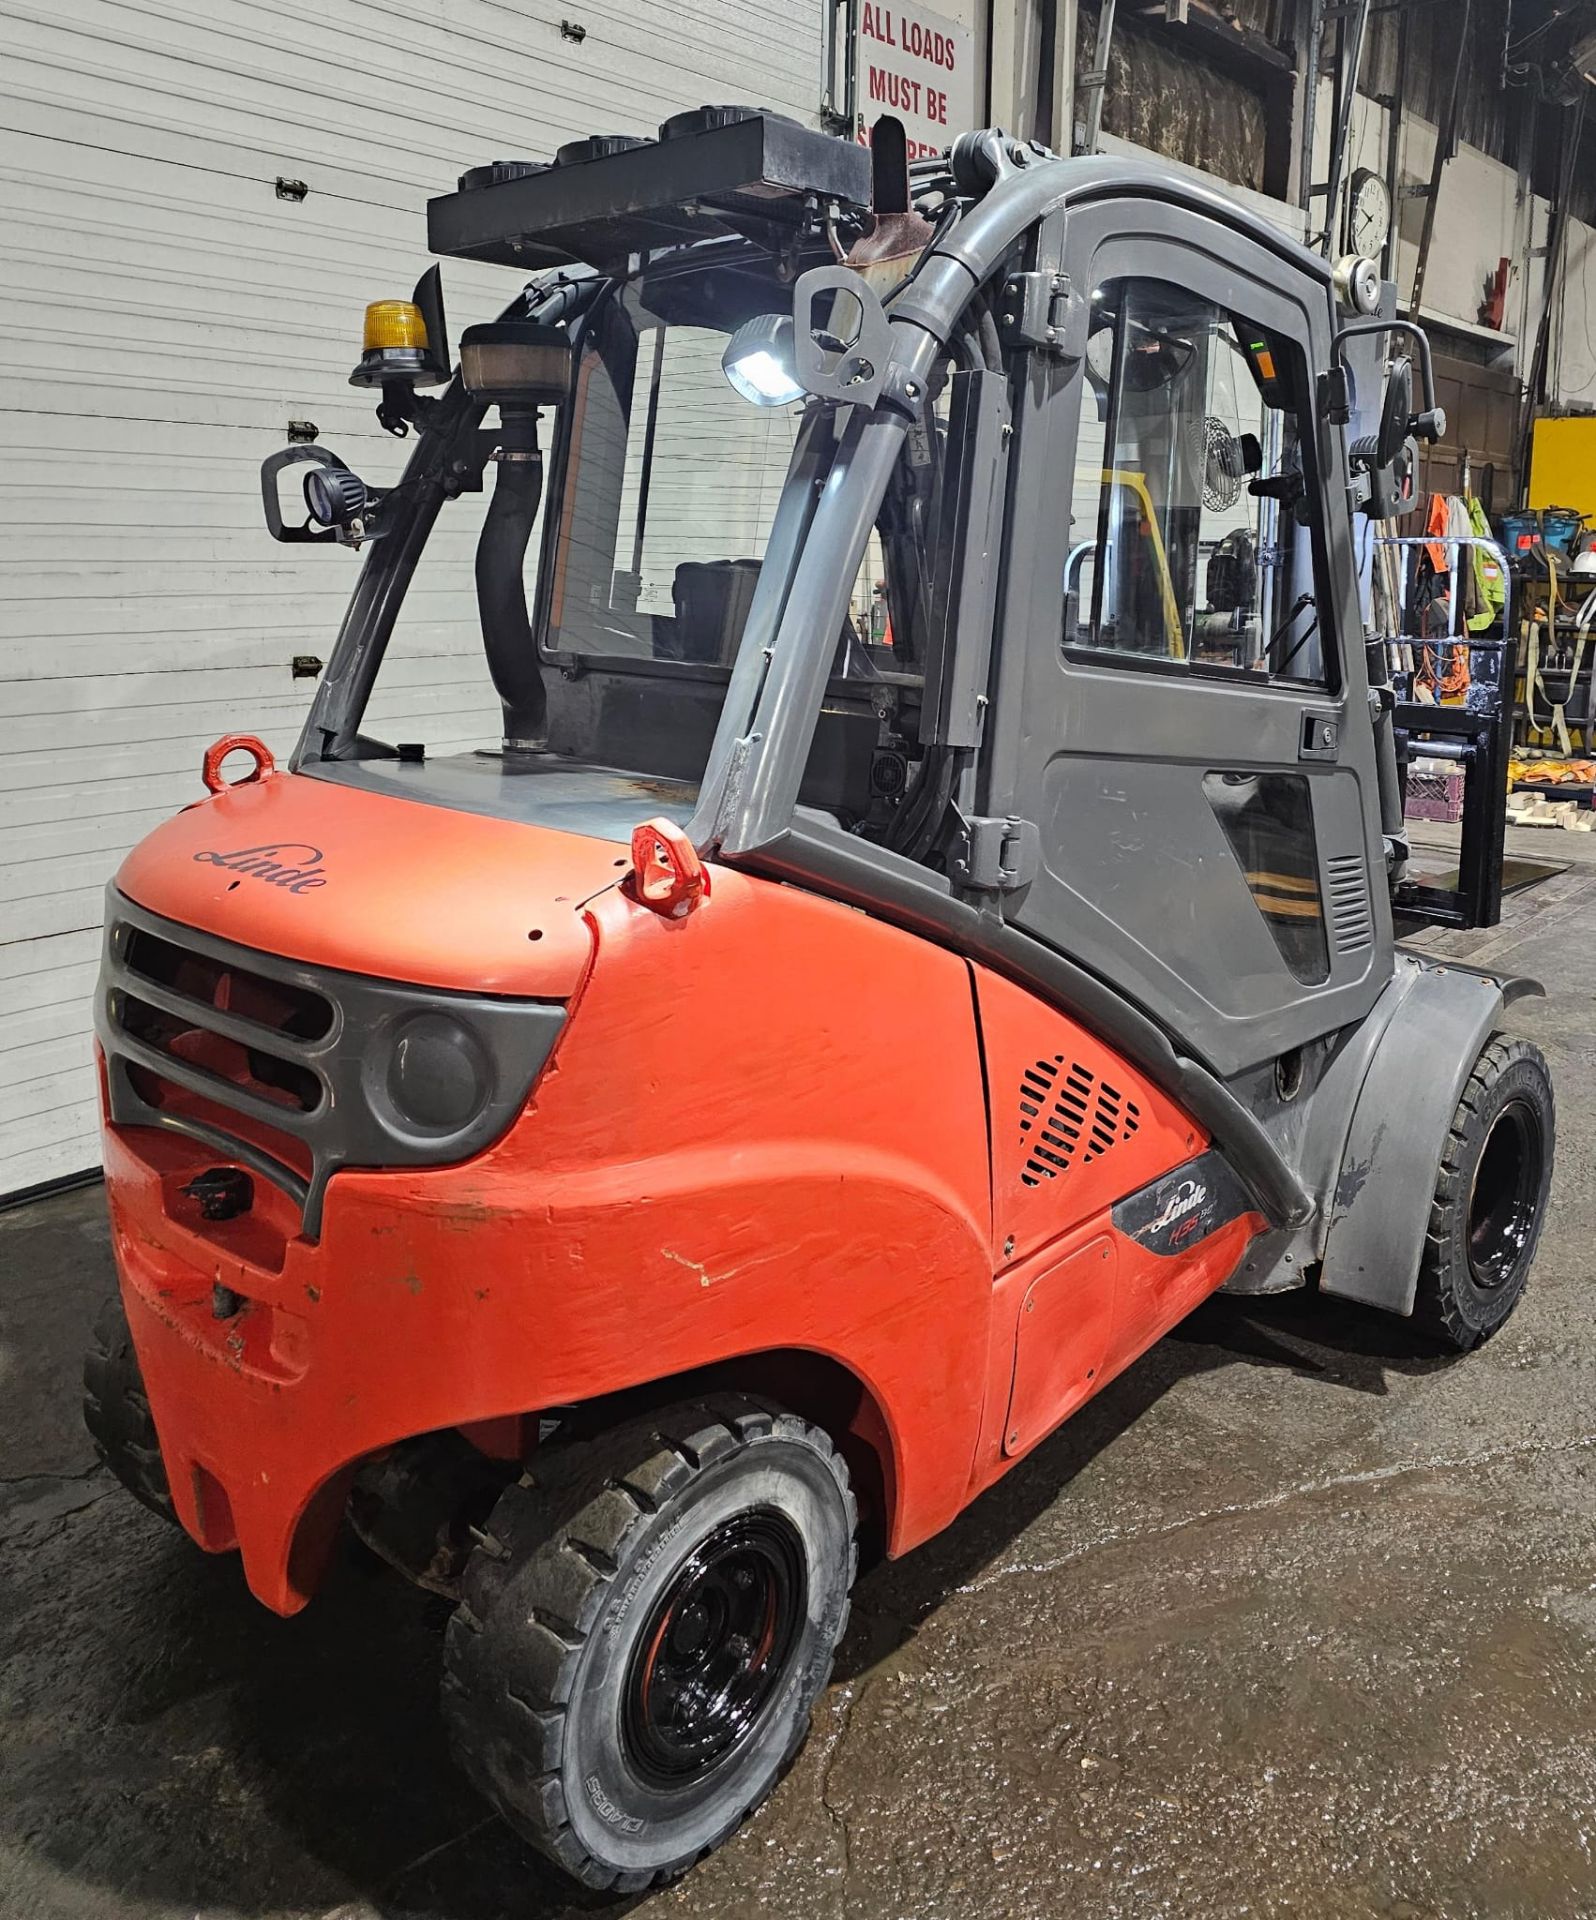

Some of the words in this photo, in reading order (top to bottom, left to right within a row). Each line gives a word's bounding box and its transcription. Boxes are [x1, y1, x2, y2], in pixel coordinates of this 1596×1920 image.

[862, 2, 896, 46] ALL
[902, 17, 955, 71] LOADS
[869, 65, 921, 114] MUST
[927, 87, 947, 125] BE
[193, 844, 327, 894] Linde
[1151, 1180, 1207, 1233] Linde
